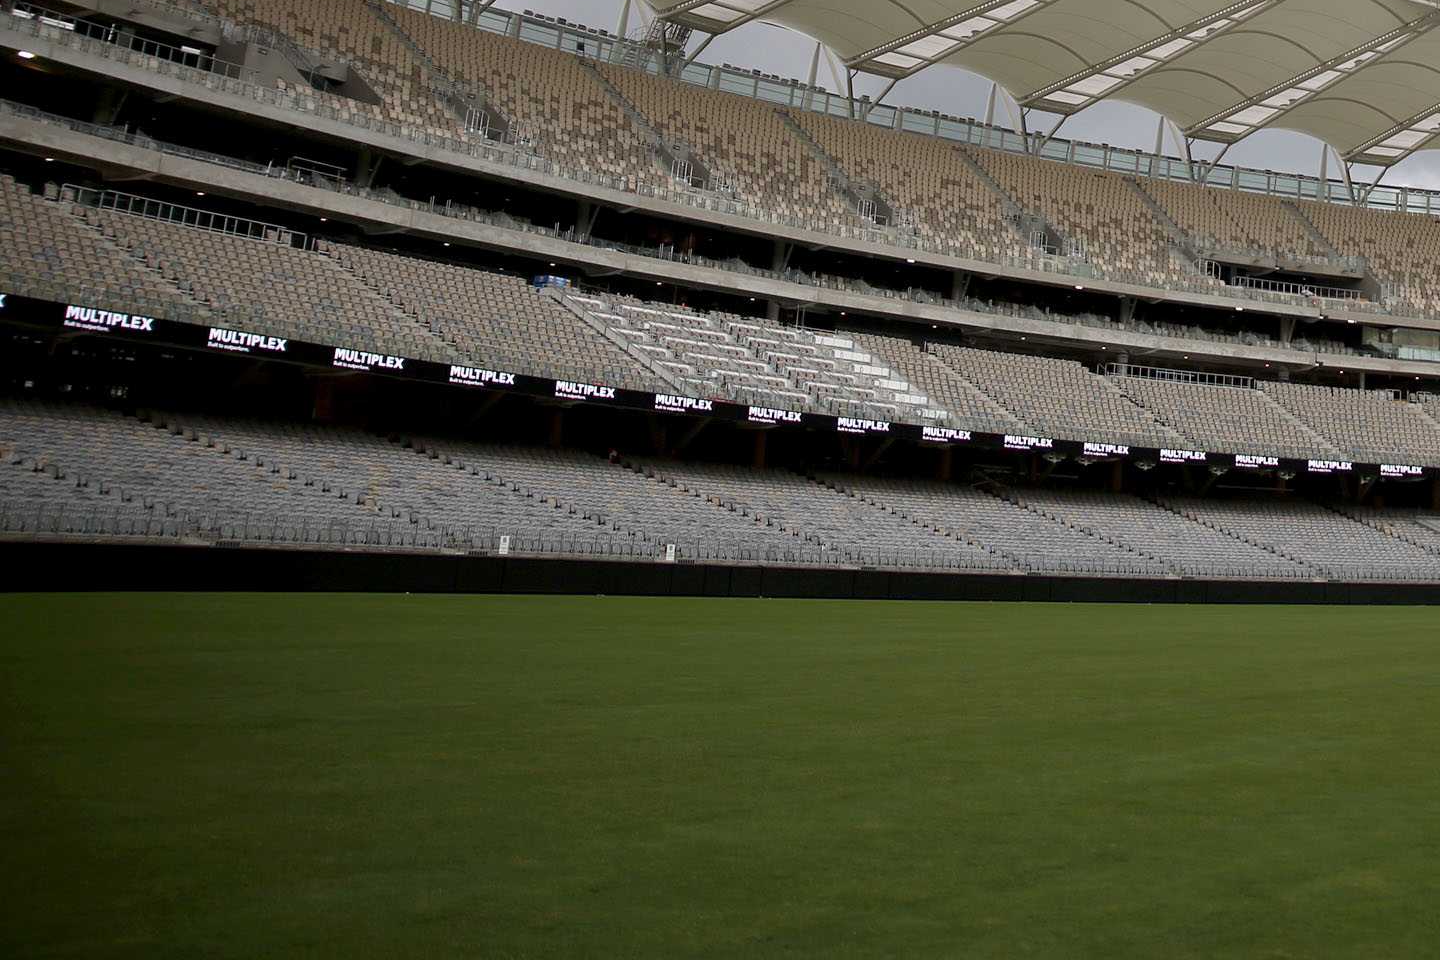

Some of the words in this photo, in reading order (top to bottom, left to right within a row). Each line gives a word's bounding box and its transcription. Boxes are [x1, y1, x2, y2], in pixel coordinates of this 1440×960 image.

[65, 305, 154, 331] MULTIPLEX
[208, 327, 287, 351] MULTIPLEX
[334, 347, 405, 369] MULTIPLEX
[450, 365, 515, 385] MULTIPLEX
[555, 380, 616, 399] MULTIPLEX
[655, 393, 713, 410] MULTIPLEX
[748, 406, 802, 422] MULTIPLEX
[837, 416, 890, 431] MULTIPLEX
[922, 426, 971, 441] MULTIPLEX
[1004, 434, 1053, 448] MULTIPLEX
[1083, 442, 1129, 455] MULTIPLEX
[1159, 448, 1206, 460] MULTIPLEX
[1235, 454, 1279, 466] MULTIPLEX
[1307, 459, 1353, 470] MULTIPLEX
[1380, 464, 1423, 474] MULTIPLEX
